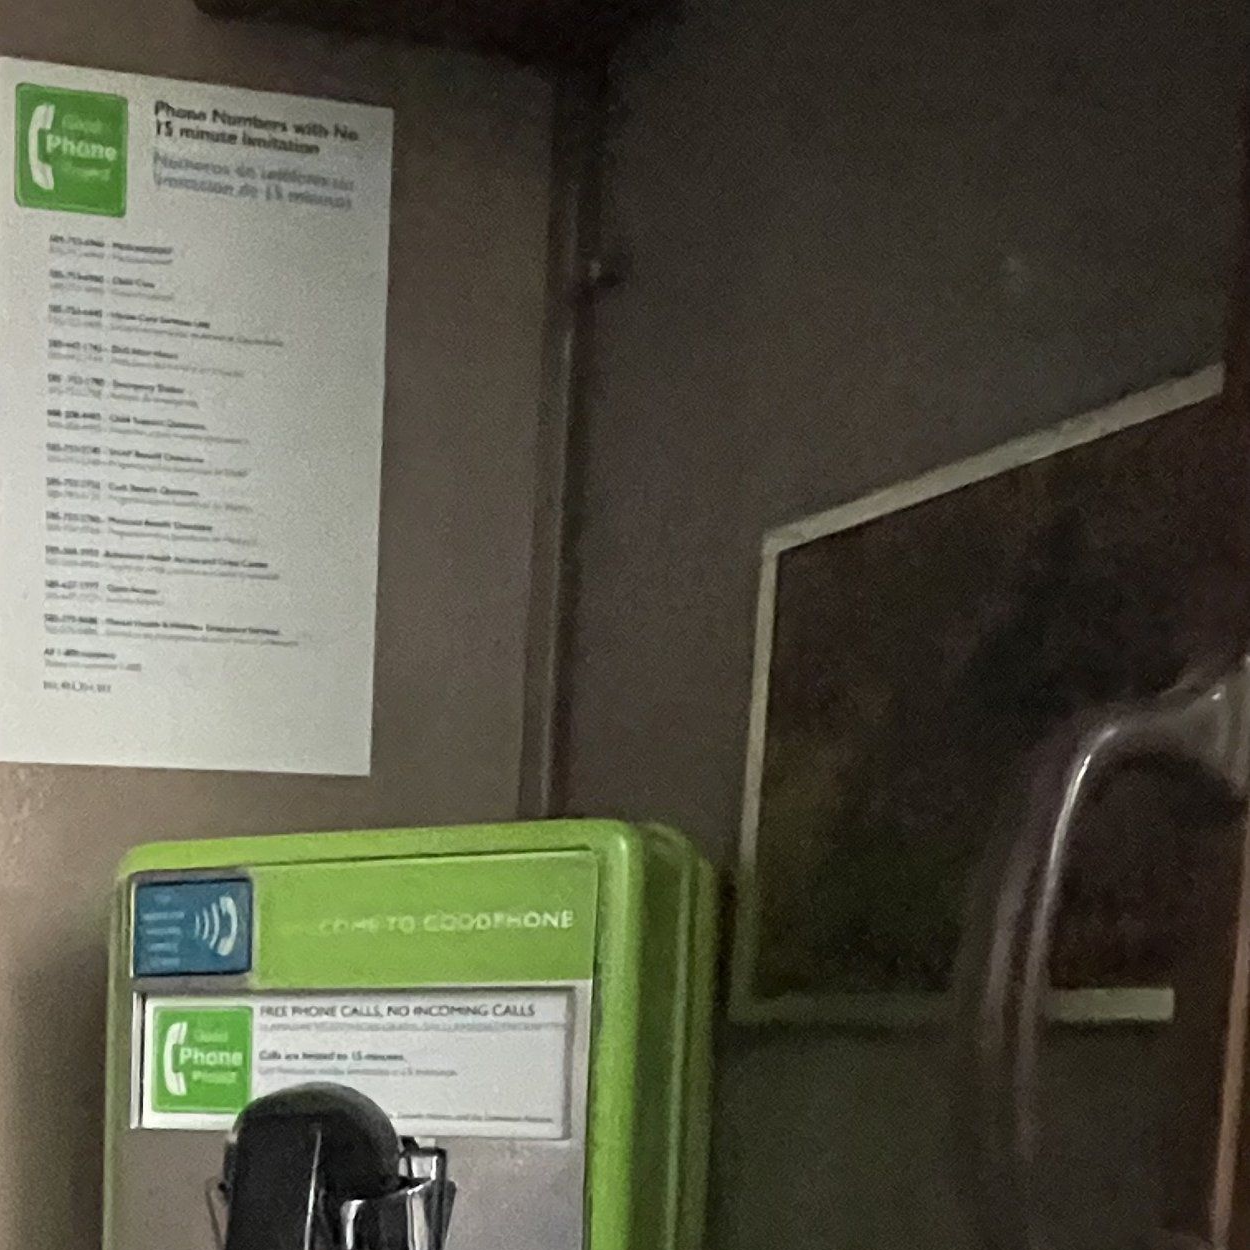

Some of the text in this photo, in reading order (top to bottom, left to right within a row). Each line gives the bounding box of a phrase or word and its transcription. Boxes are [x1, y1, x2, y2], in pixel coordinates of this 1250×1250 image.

[155, 100, 207, 121] Phone
[212, 109, 288, 132] Numbers
[46, 133, 117, 162] Phone
[386, 914, 416, 934] TO
[387, 1005, 410, 1017] NO
[492, 1004, 535, 1017] CALLS
[179, 1047, 243, 1067] Phone
